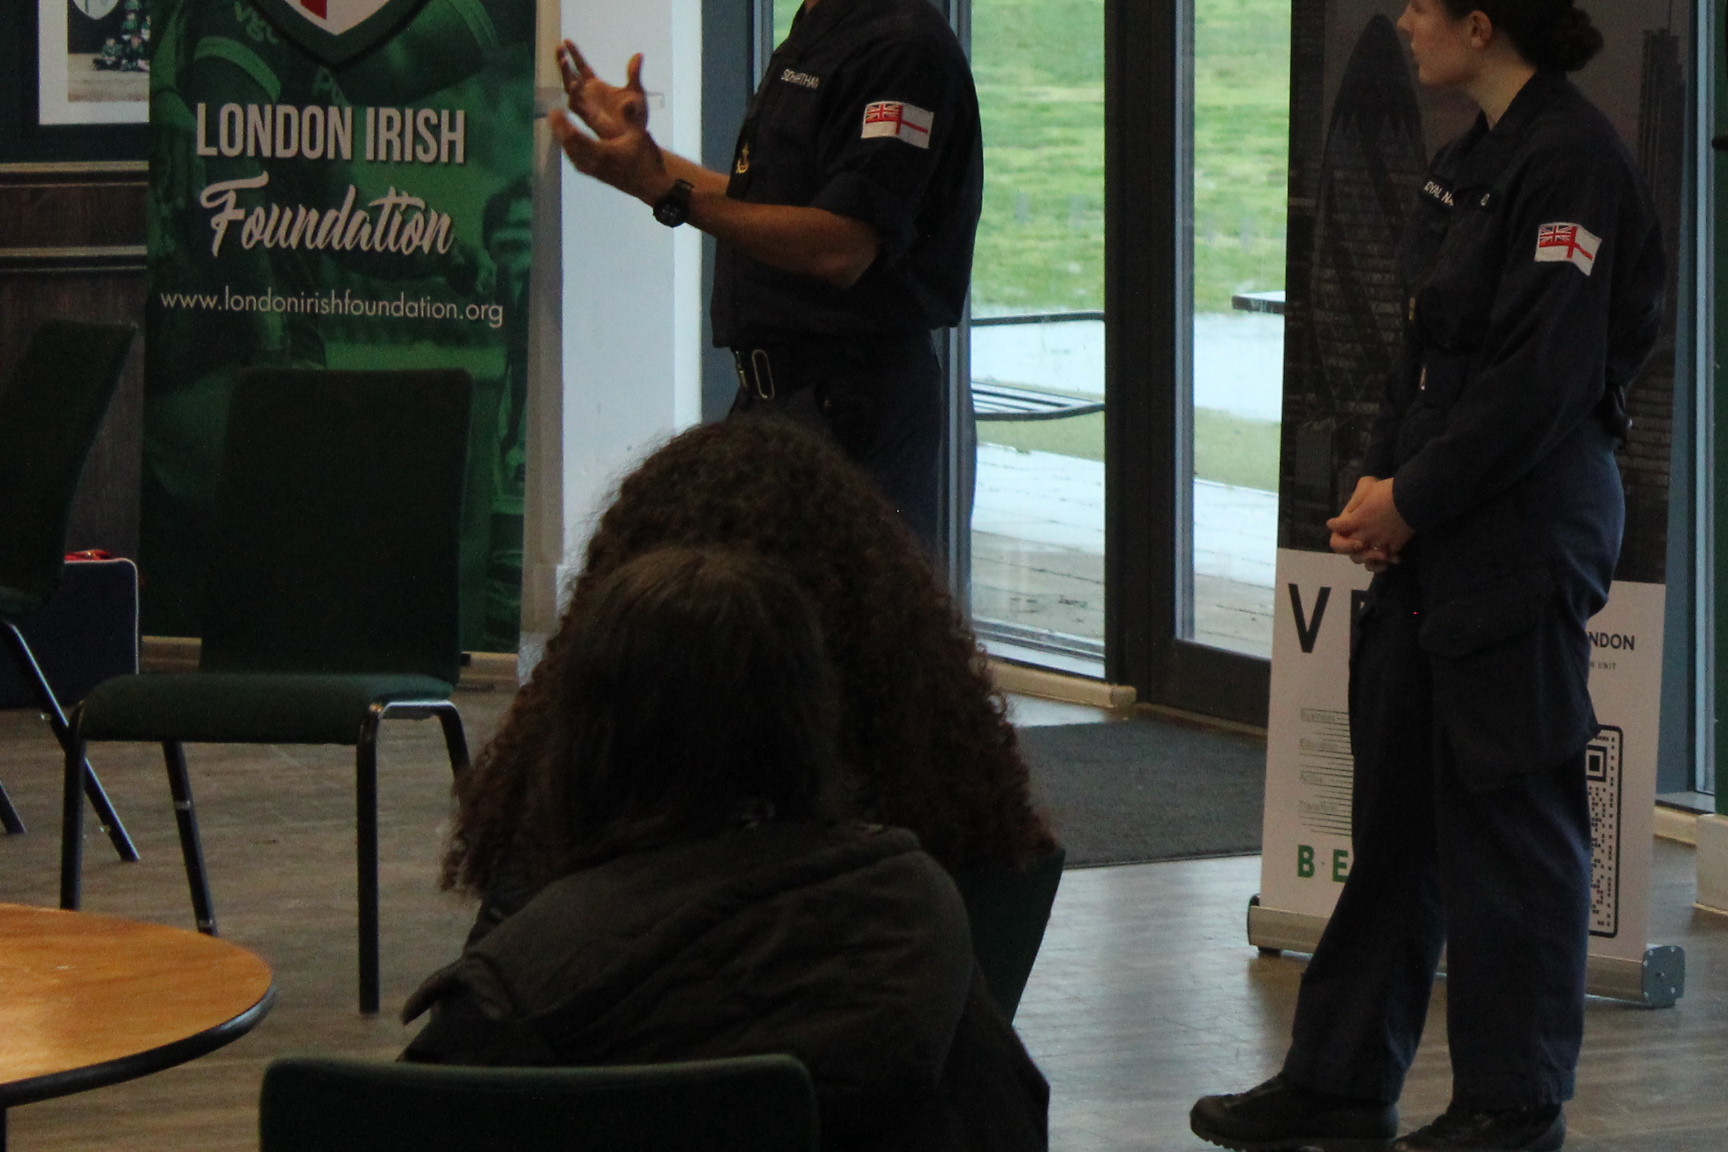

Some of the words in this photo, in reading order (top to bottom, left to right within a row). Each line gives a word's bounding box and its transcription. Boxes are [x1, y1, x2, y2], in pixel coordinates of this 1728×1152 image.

[196, 103, 352, 160] LONDON
[366, 107, 466, 164] IRISH
[200, 170, 455, 258] Foundation
[160, 285, 503, 328] www.londonirishfoundation.org
[1588, 631, 1635, 651] NDON
